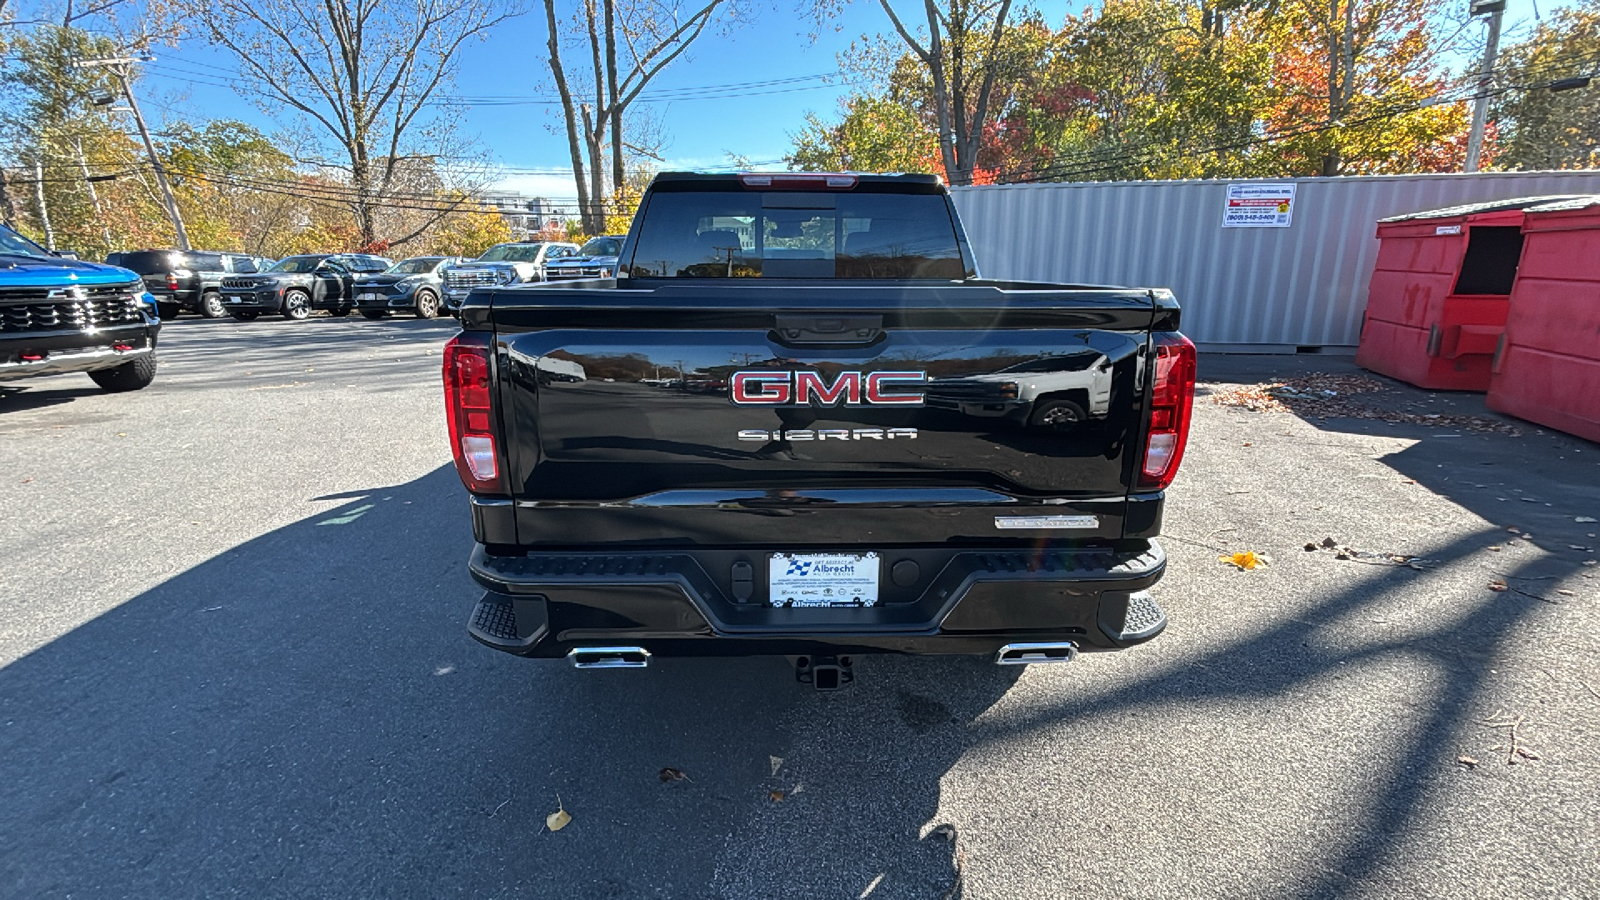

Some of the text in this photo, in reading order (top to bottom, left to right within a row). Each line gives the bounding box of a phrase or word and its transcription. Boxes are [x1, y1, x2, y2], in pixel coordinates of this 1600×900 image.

[732, 371, 926, 405] GMC
[737, 427, 918, 442] SIERRA
[813, 564, 855, 573] Albrecht
